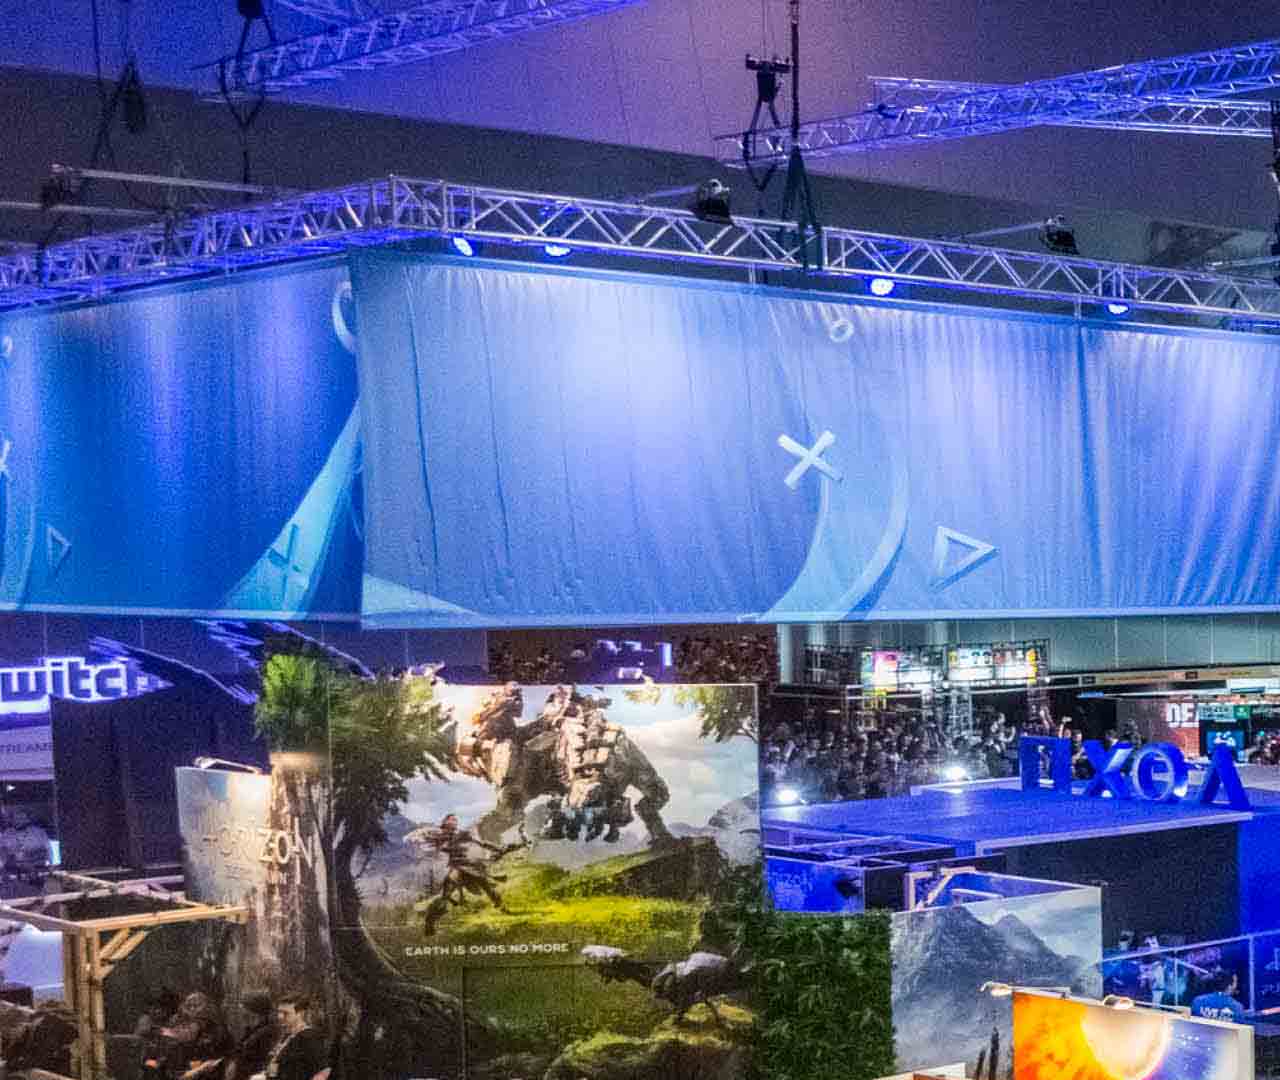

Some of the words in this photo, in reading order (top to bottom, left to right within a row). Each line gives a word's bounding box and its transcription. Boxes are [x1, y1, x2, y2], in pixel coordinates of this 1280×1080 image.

[405, 946, 450, 957] EARTH
[453, 945, 466, 956] IS
[470, 944, 506, 955] OURS
[510, 943, 529, 954] NO
[532, 942, 569, 953] MORE
